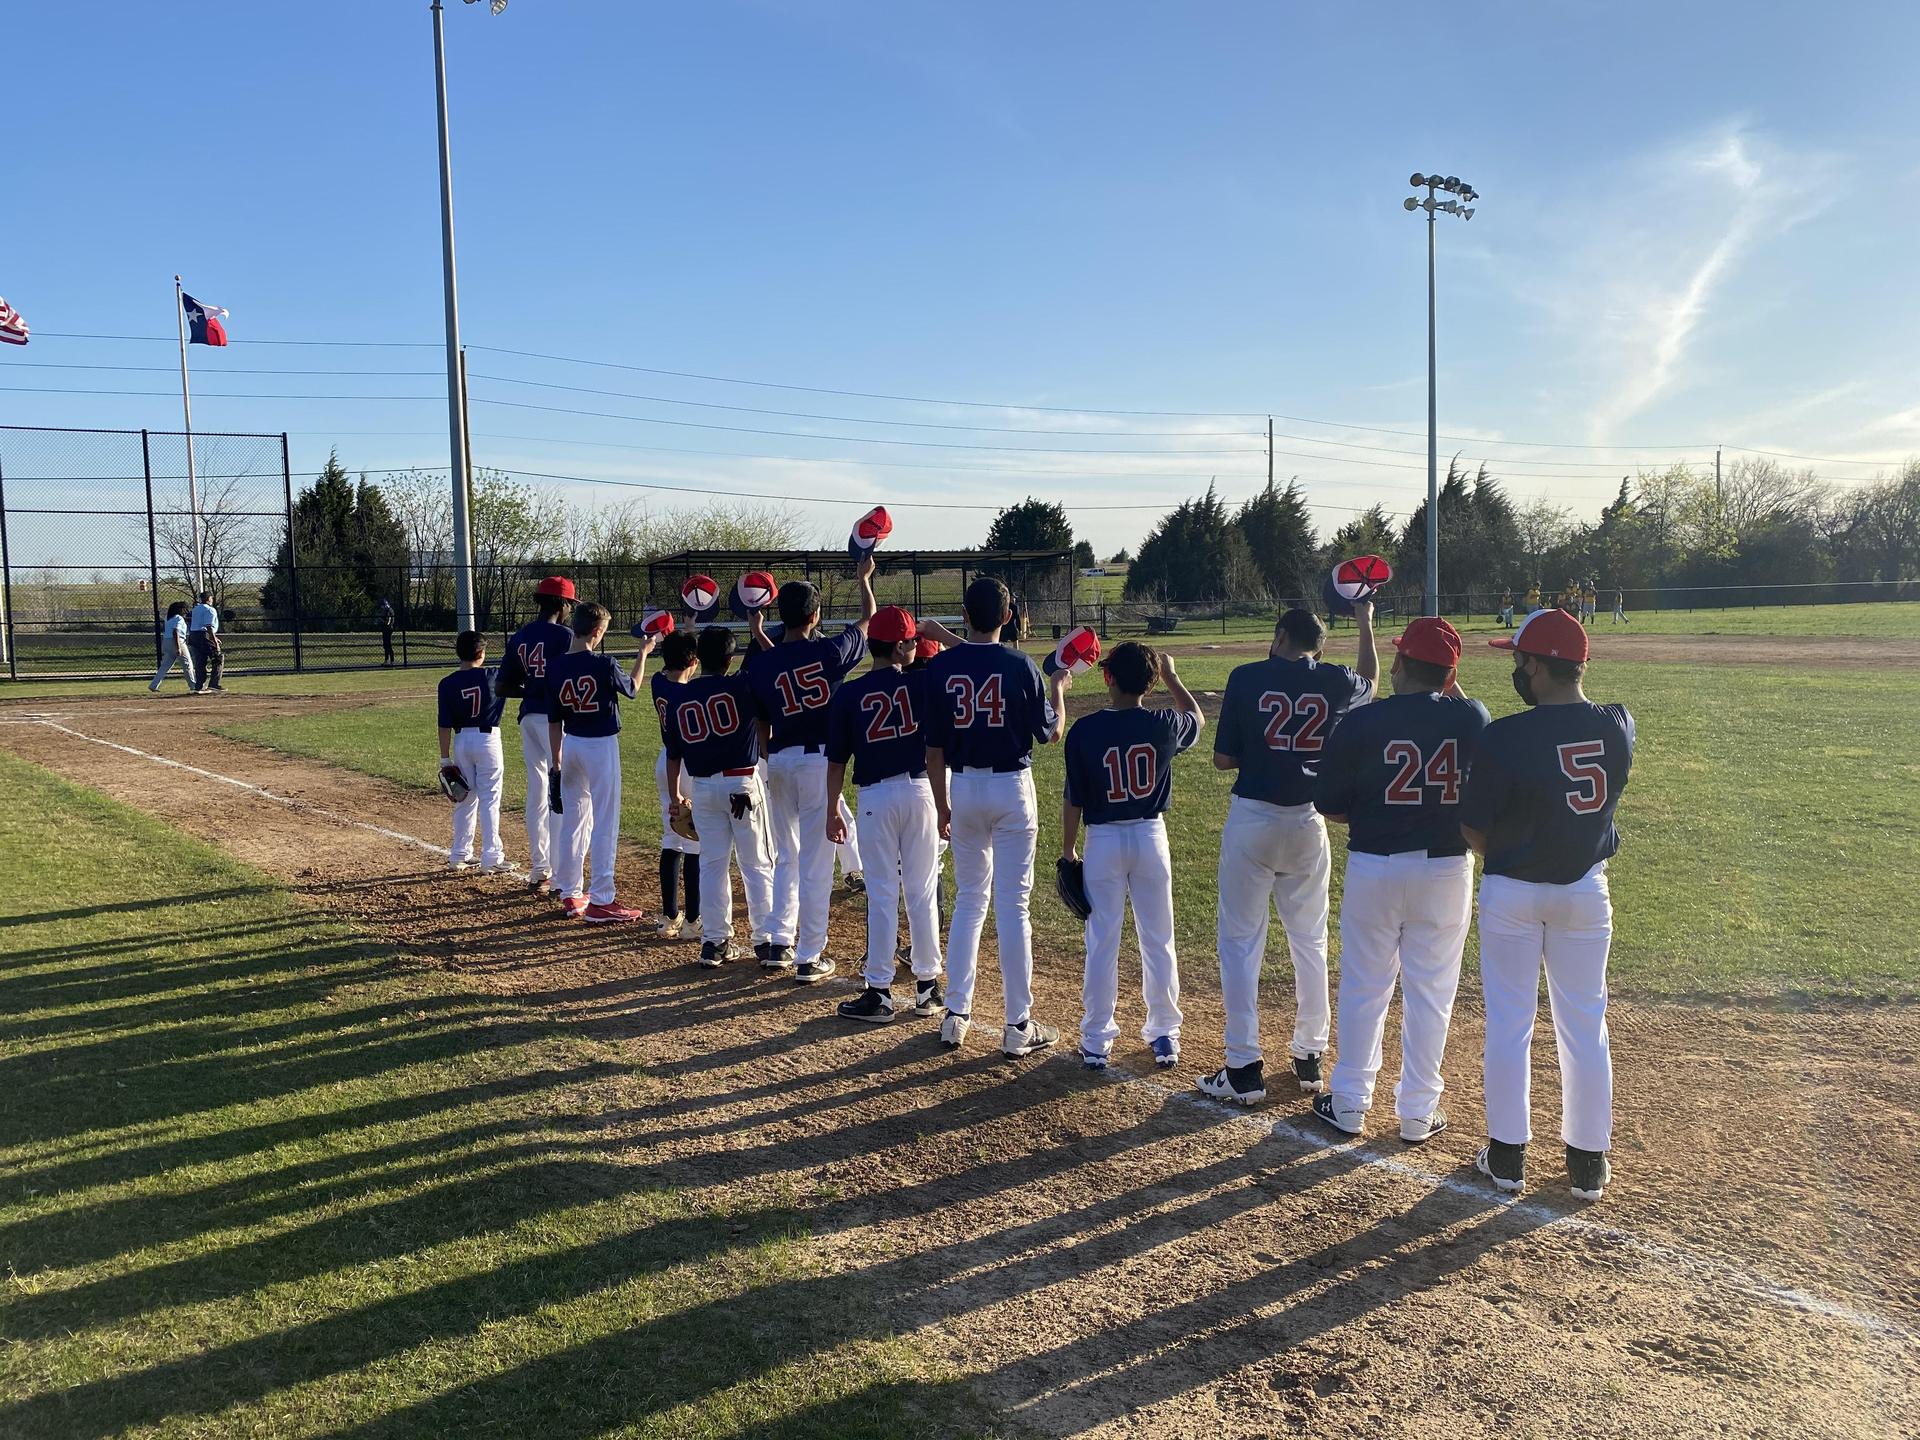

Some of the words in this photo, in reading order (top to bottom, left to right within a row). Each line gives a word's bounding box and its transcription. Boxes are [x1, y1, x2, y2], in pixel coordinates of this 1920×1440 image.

[518, 642, 546, 677] 14
[462, 686, 481, 718] 7
[559, 675, 599, 712] 42
[775, 661, 831, 716] 15
[861, 686, 919, 743] 21
[946, 673, 1006, 728] 34
[676, 692, 740, 744] 00
[1258, 690, 1329, 751] 22
[1103, 743, 1157, 803] 10
[1383, 738, 1462, 805] 24
[1556, 740, 1608, 815] 5
